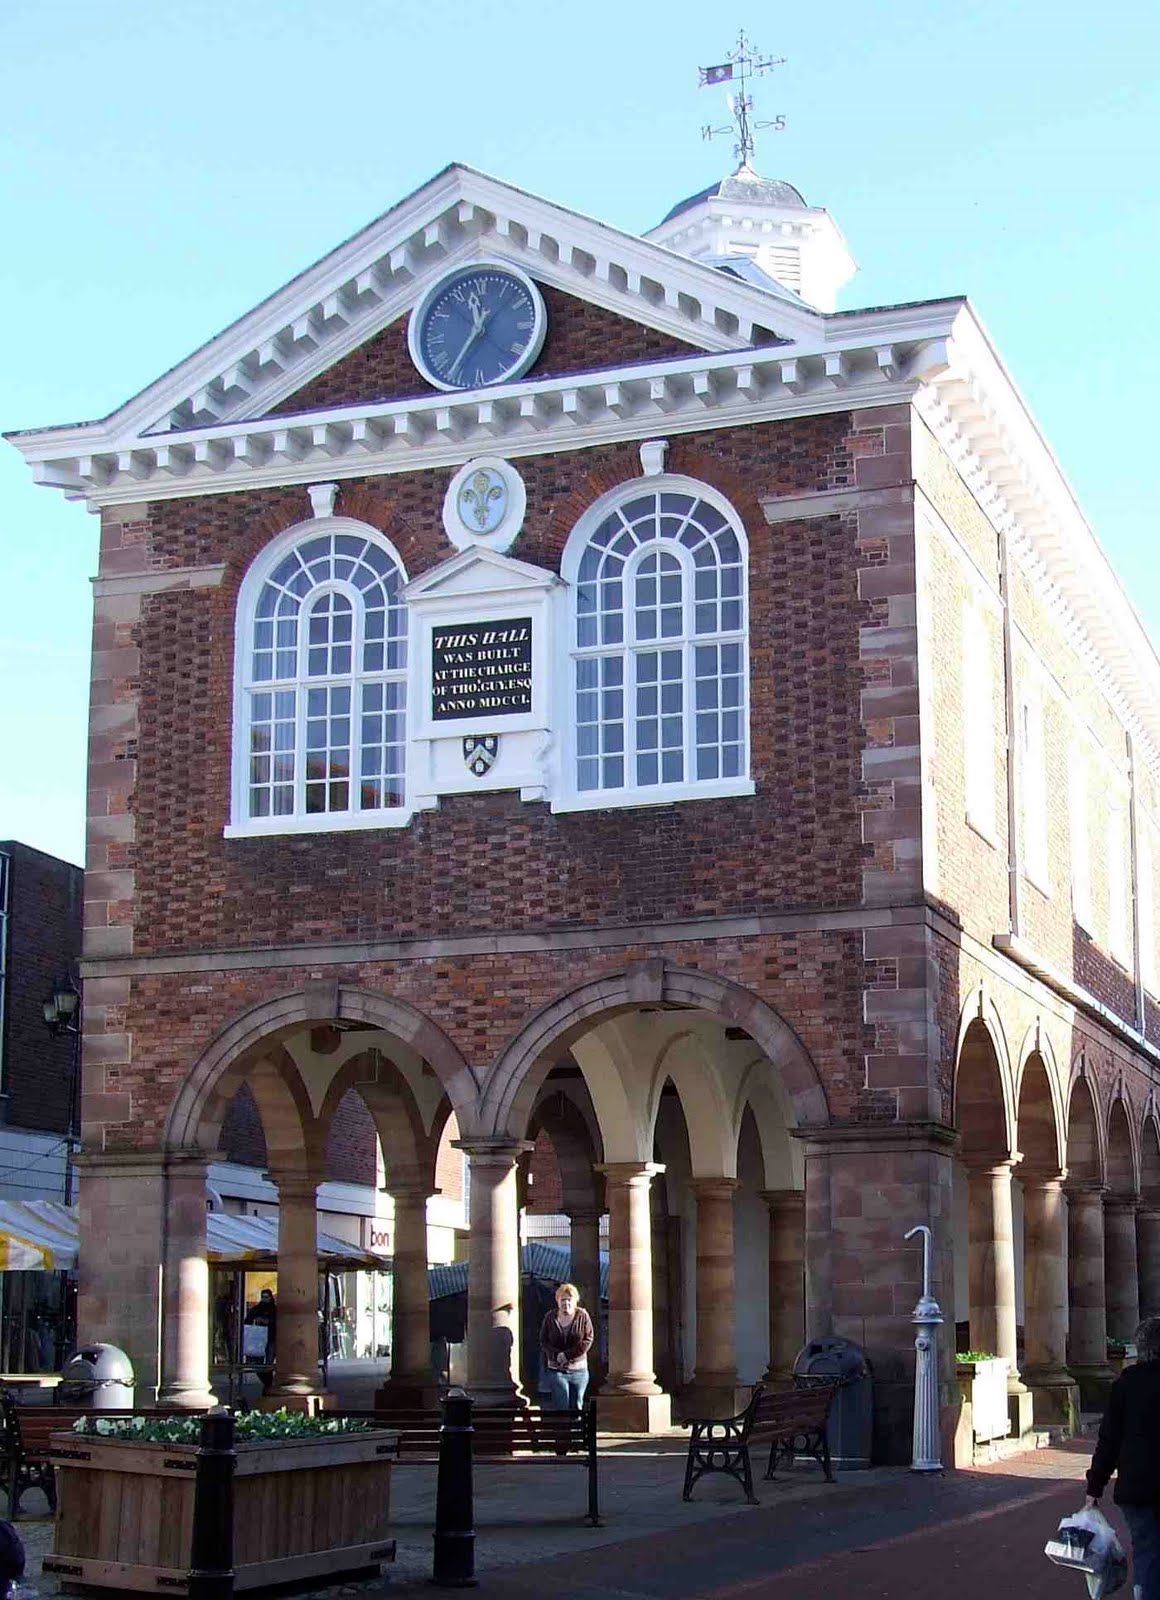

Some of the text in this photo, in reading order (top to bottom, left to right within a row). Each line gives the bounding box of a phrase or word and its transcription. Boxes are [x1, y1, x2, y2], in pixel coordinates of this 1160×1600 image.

[434, 628, 529, 649] THIS HALL
[443, 647, 521, 664] WAS BUILT
[434, 662, 531, 681] AT THE CHARGE
[432, 685, 449, 696] OF
[437, 699, 476, 712] ANNO
